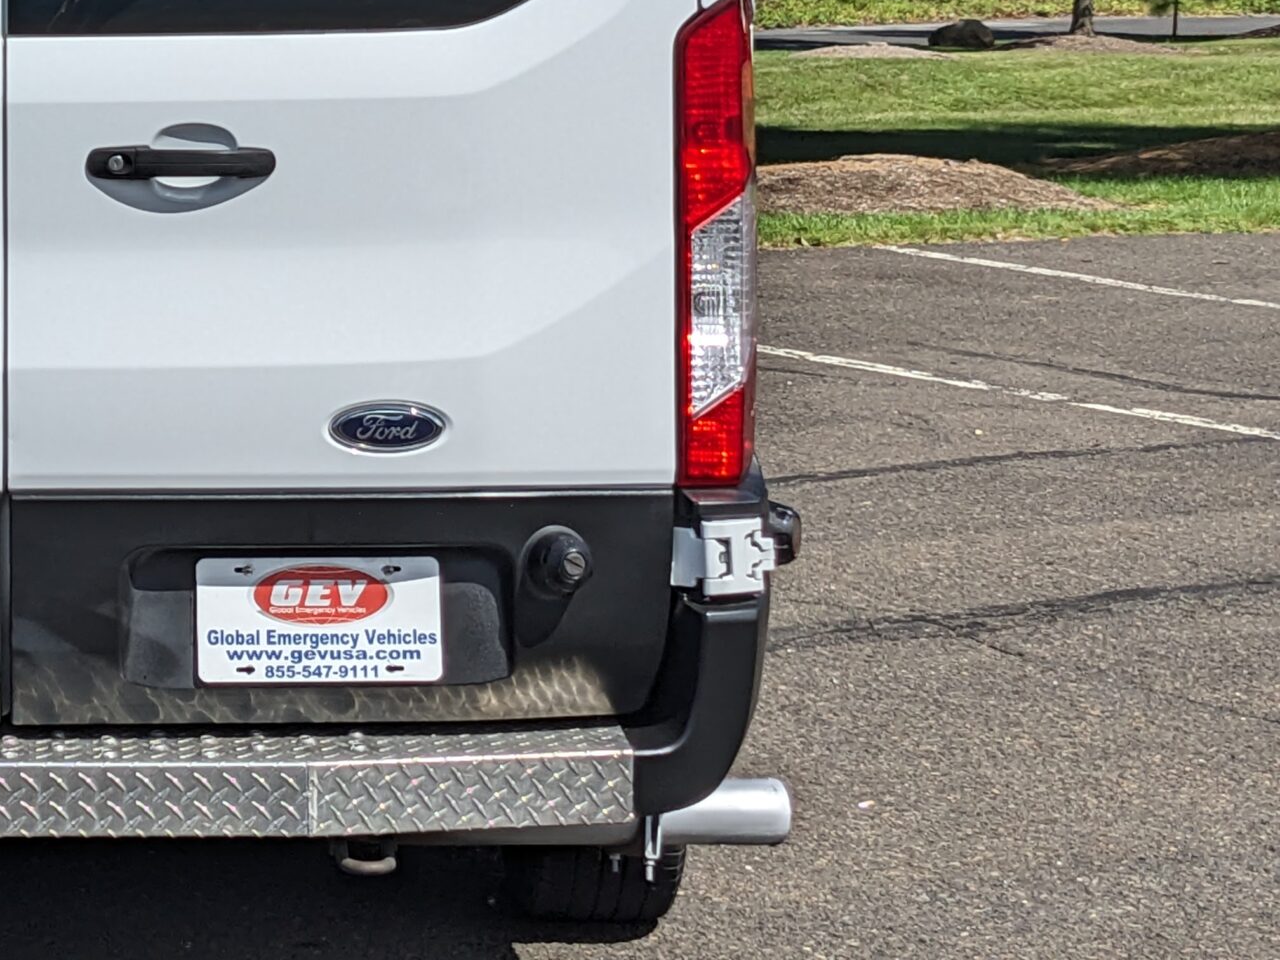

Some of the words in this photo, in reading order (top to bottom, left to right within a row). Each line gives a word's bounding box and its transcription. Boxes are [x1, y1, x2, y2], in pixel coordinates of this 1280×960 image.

[356, 414, 418, 440] Ford
[269, 579, 369, 607] GEV
[269, 606, 294, 614] Global
[295, 606, 336, 615] Emergency
[337, 606, 367, 614] Vehicles
[207, 629, 260, 646] Global
[266, 630, 360, 649] Emergency
[365, 629, 437, 645] Vehicles
[226, 648, 421, 663] www.gevusa.com
[265, 664, 379, 679] 855-547-9111
